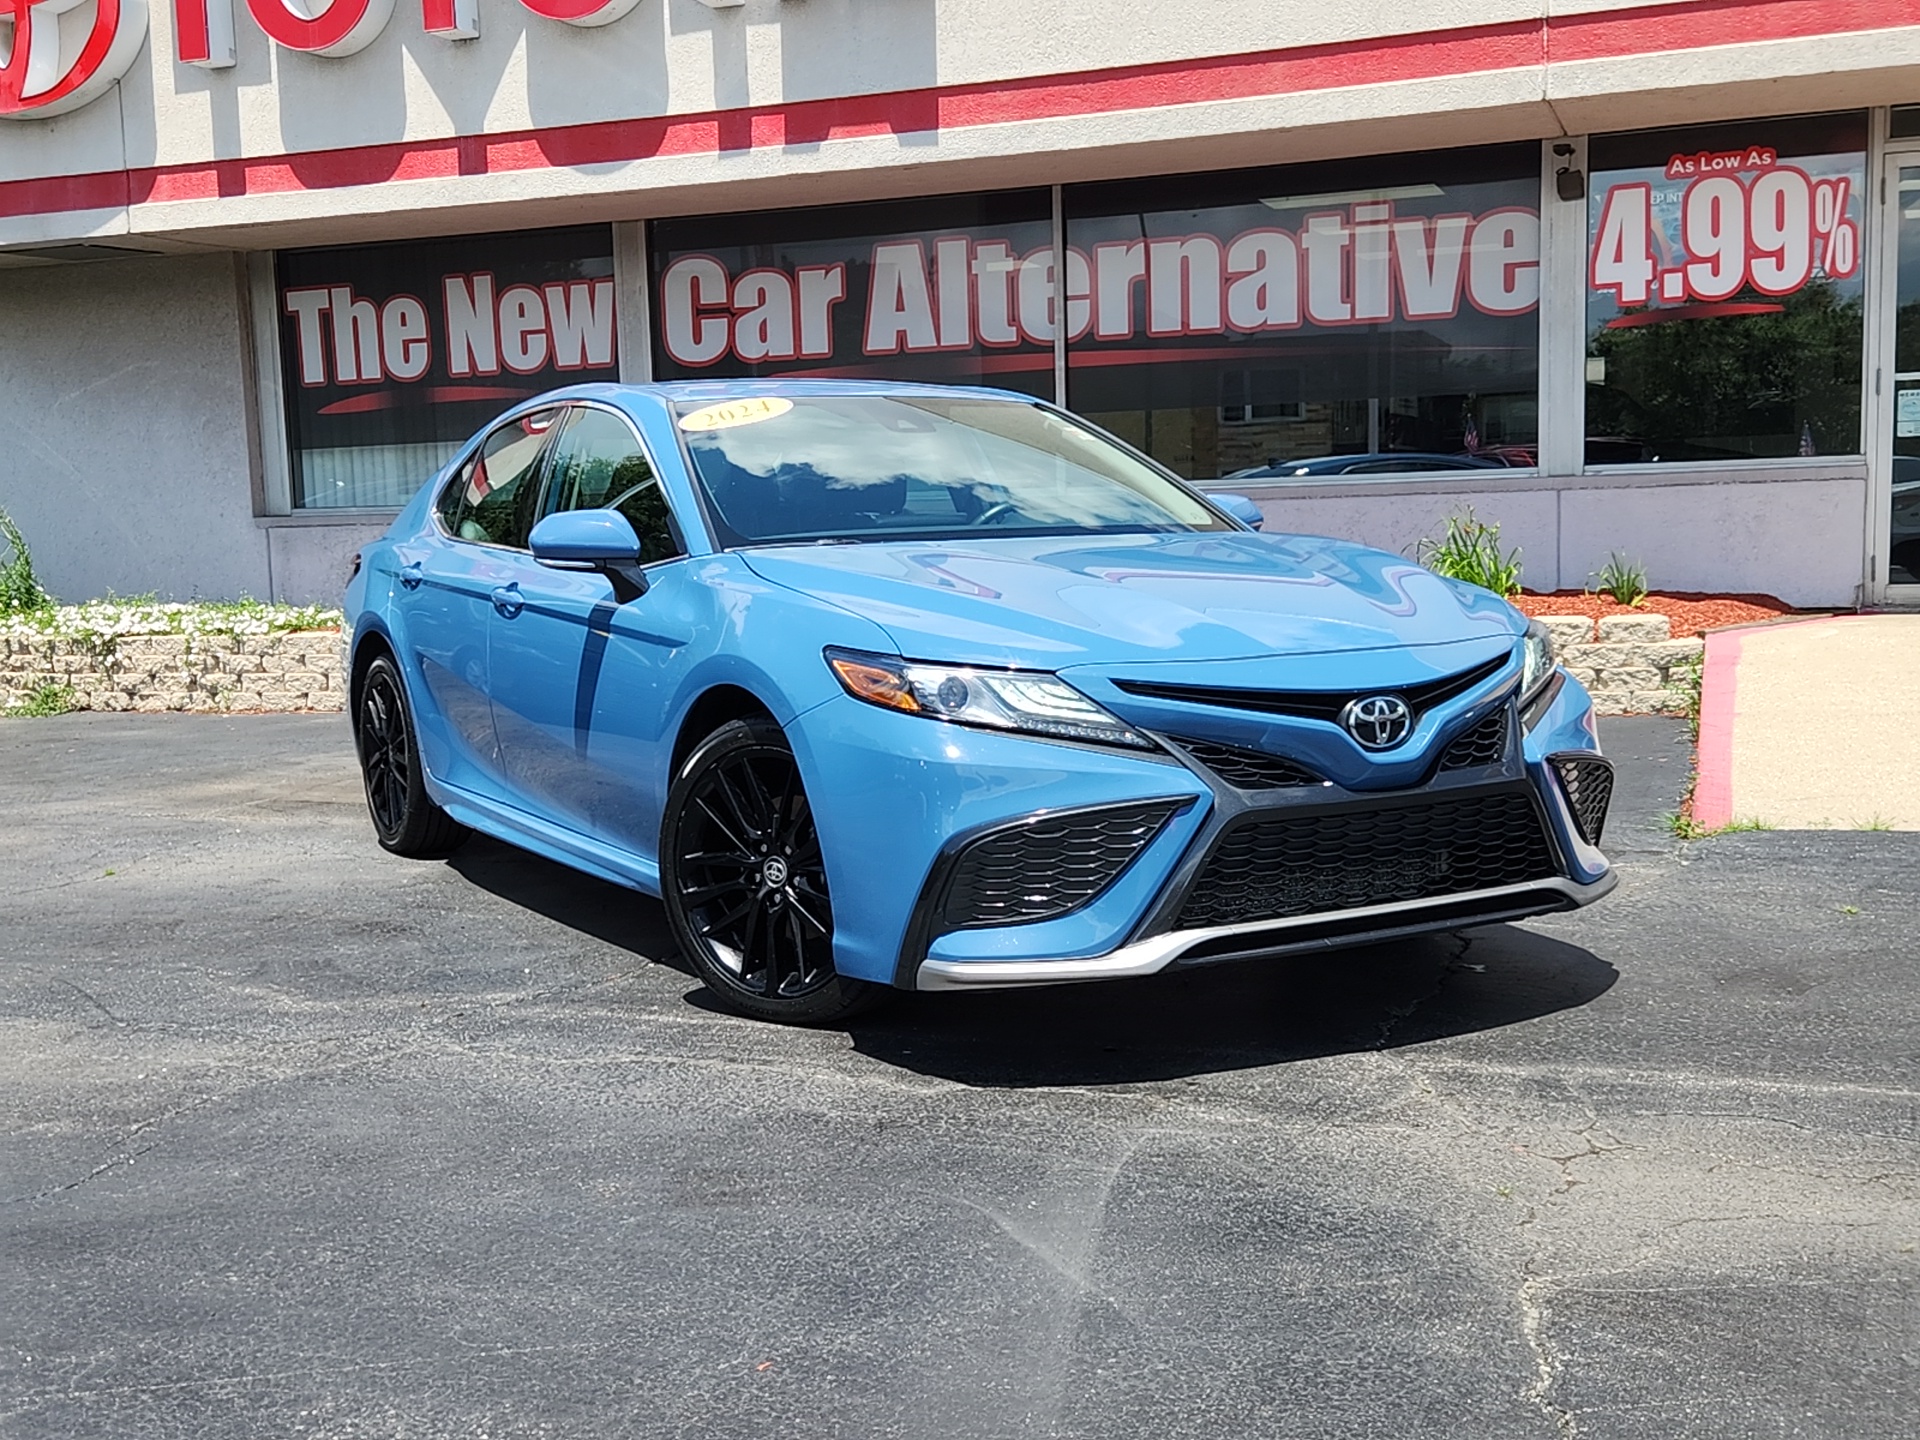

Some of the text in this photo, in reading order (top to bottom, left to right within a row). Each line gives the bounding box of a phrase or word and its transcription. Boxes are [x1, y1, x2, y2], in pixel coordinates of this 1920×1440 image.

[1670, 150, 1772, 174] As Low As
[1592, 168, 1856, 304] 4.99%
[286, 201, 1540, 386] The New Car Alternative
[704, 400, 770, 427] 2024
